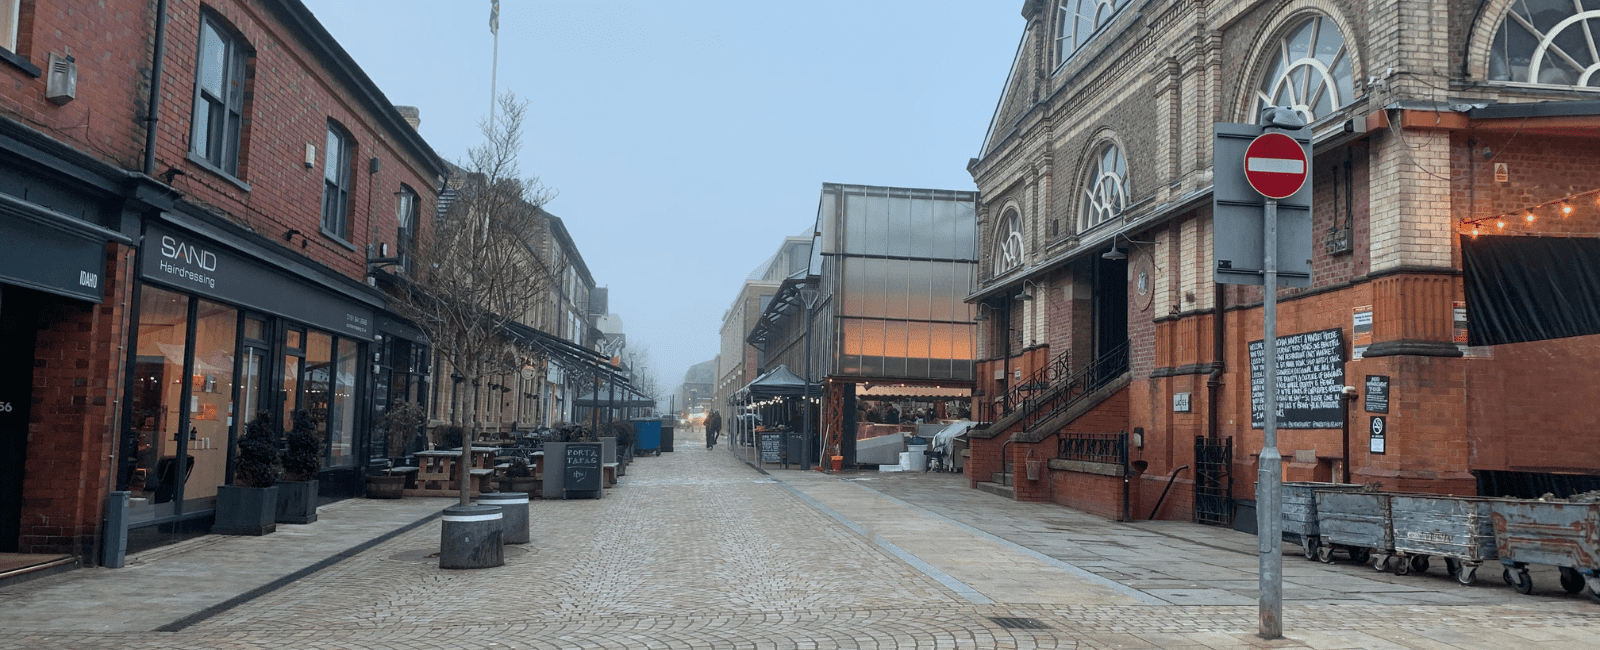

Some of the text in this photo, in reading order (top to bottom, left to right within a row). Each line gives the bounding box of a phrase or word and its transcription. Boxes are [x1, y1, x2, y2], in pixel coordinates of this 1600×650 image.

[161, 235, 217, 272] SAND
[79, 270, 98, 289] IDAHO
[159, 260, 216, 288] Hairdressing
[566, 457, 597, 465] TAPAS
[567, 449, 598, 457] PORTA
